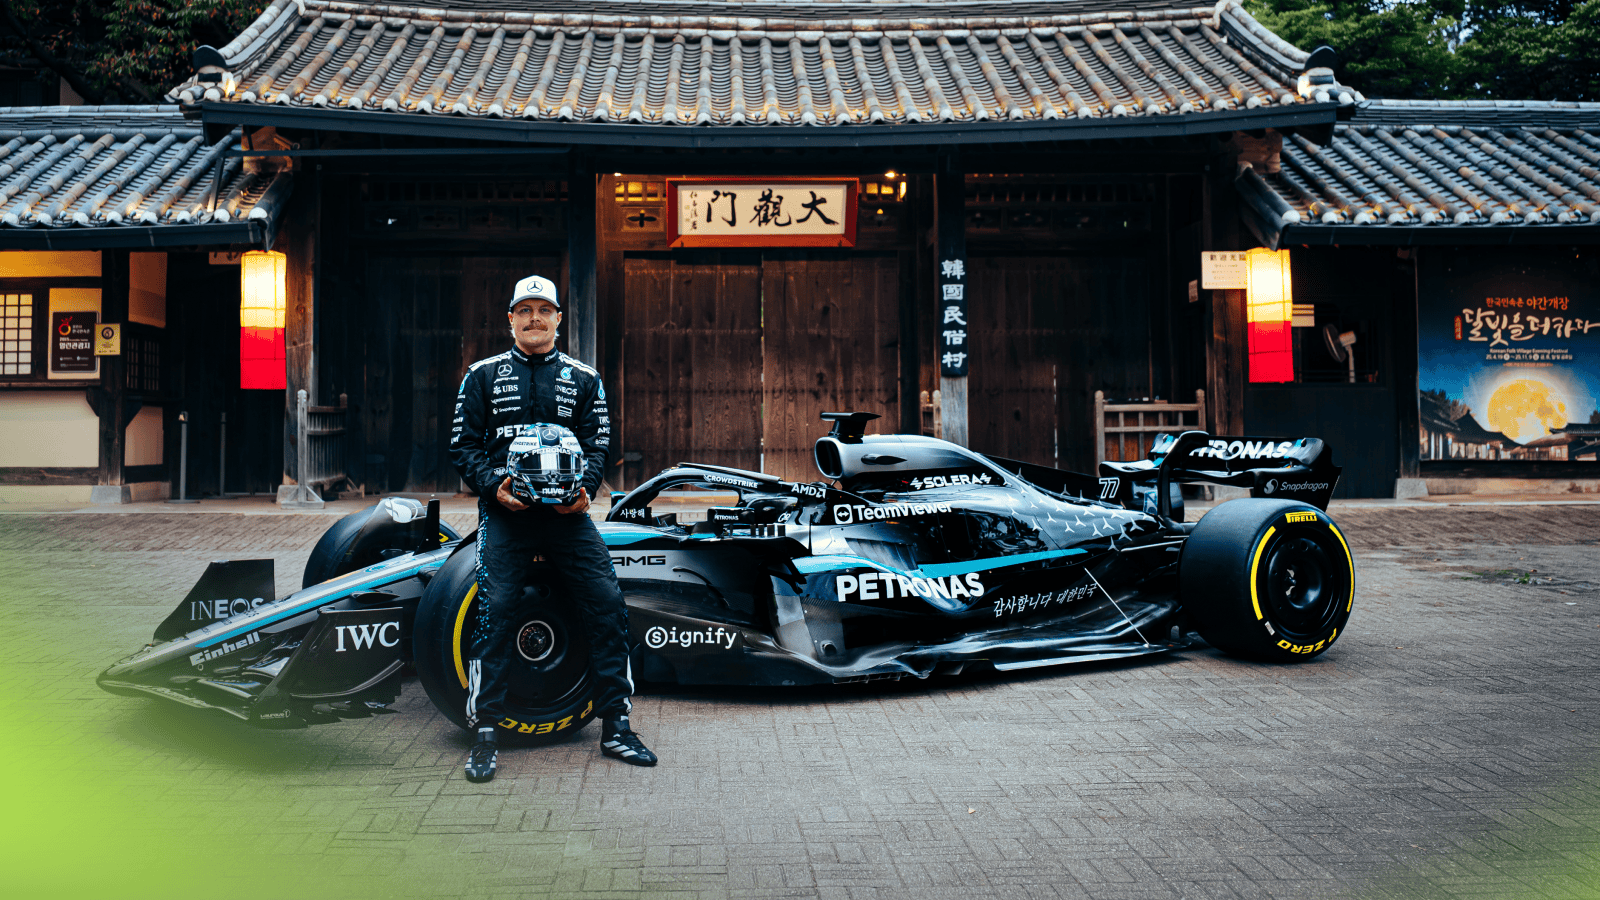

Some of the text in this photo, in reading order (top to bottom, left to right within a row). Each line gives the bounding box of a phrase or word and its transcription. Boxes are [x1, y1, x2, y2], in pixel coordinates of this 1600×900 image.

[1486, 296, 1569, 310] 한국민속촌 야간개장
[941, 259, 967, 368] 韓國民俗村
[501, 384, 519, 393] UBS
[554, 384, 578, 396] INEOS
[706, 475, 758, 489] CROWDSTRIKE
[923, 475, 980, 489] SOLERA
[1098, 477, 1120, 499] 77
[1280, 481, 1329, 492] Snapdragon
[541, 486, 565, 495] nuvei
[791, 483, 818, 497] AMD
[619, 507, 646, 519] 사랑해
[852, 502, 953, 521] TeamViewer
[1284, 511, 1318, 523] PIRELLI
[836, 572, 985, 602] PETRONAS
[993, 582, 1098, 618] 감사합니다 대한민국
[335, 621, 400, 652] IWC
[189, 631, 261, 667] Einhell
[1277, 638, 1326, 654] ZERO
[498, 714, 574, 735] ZERO
